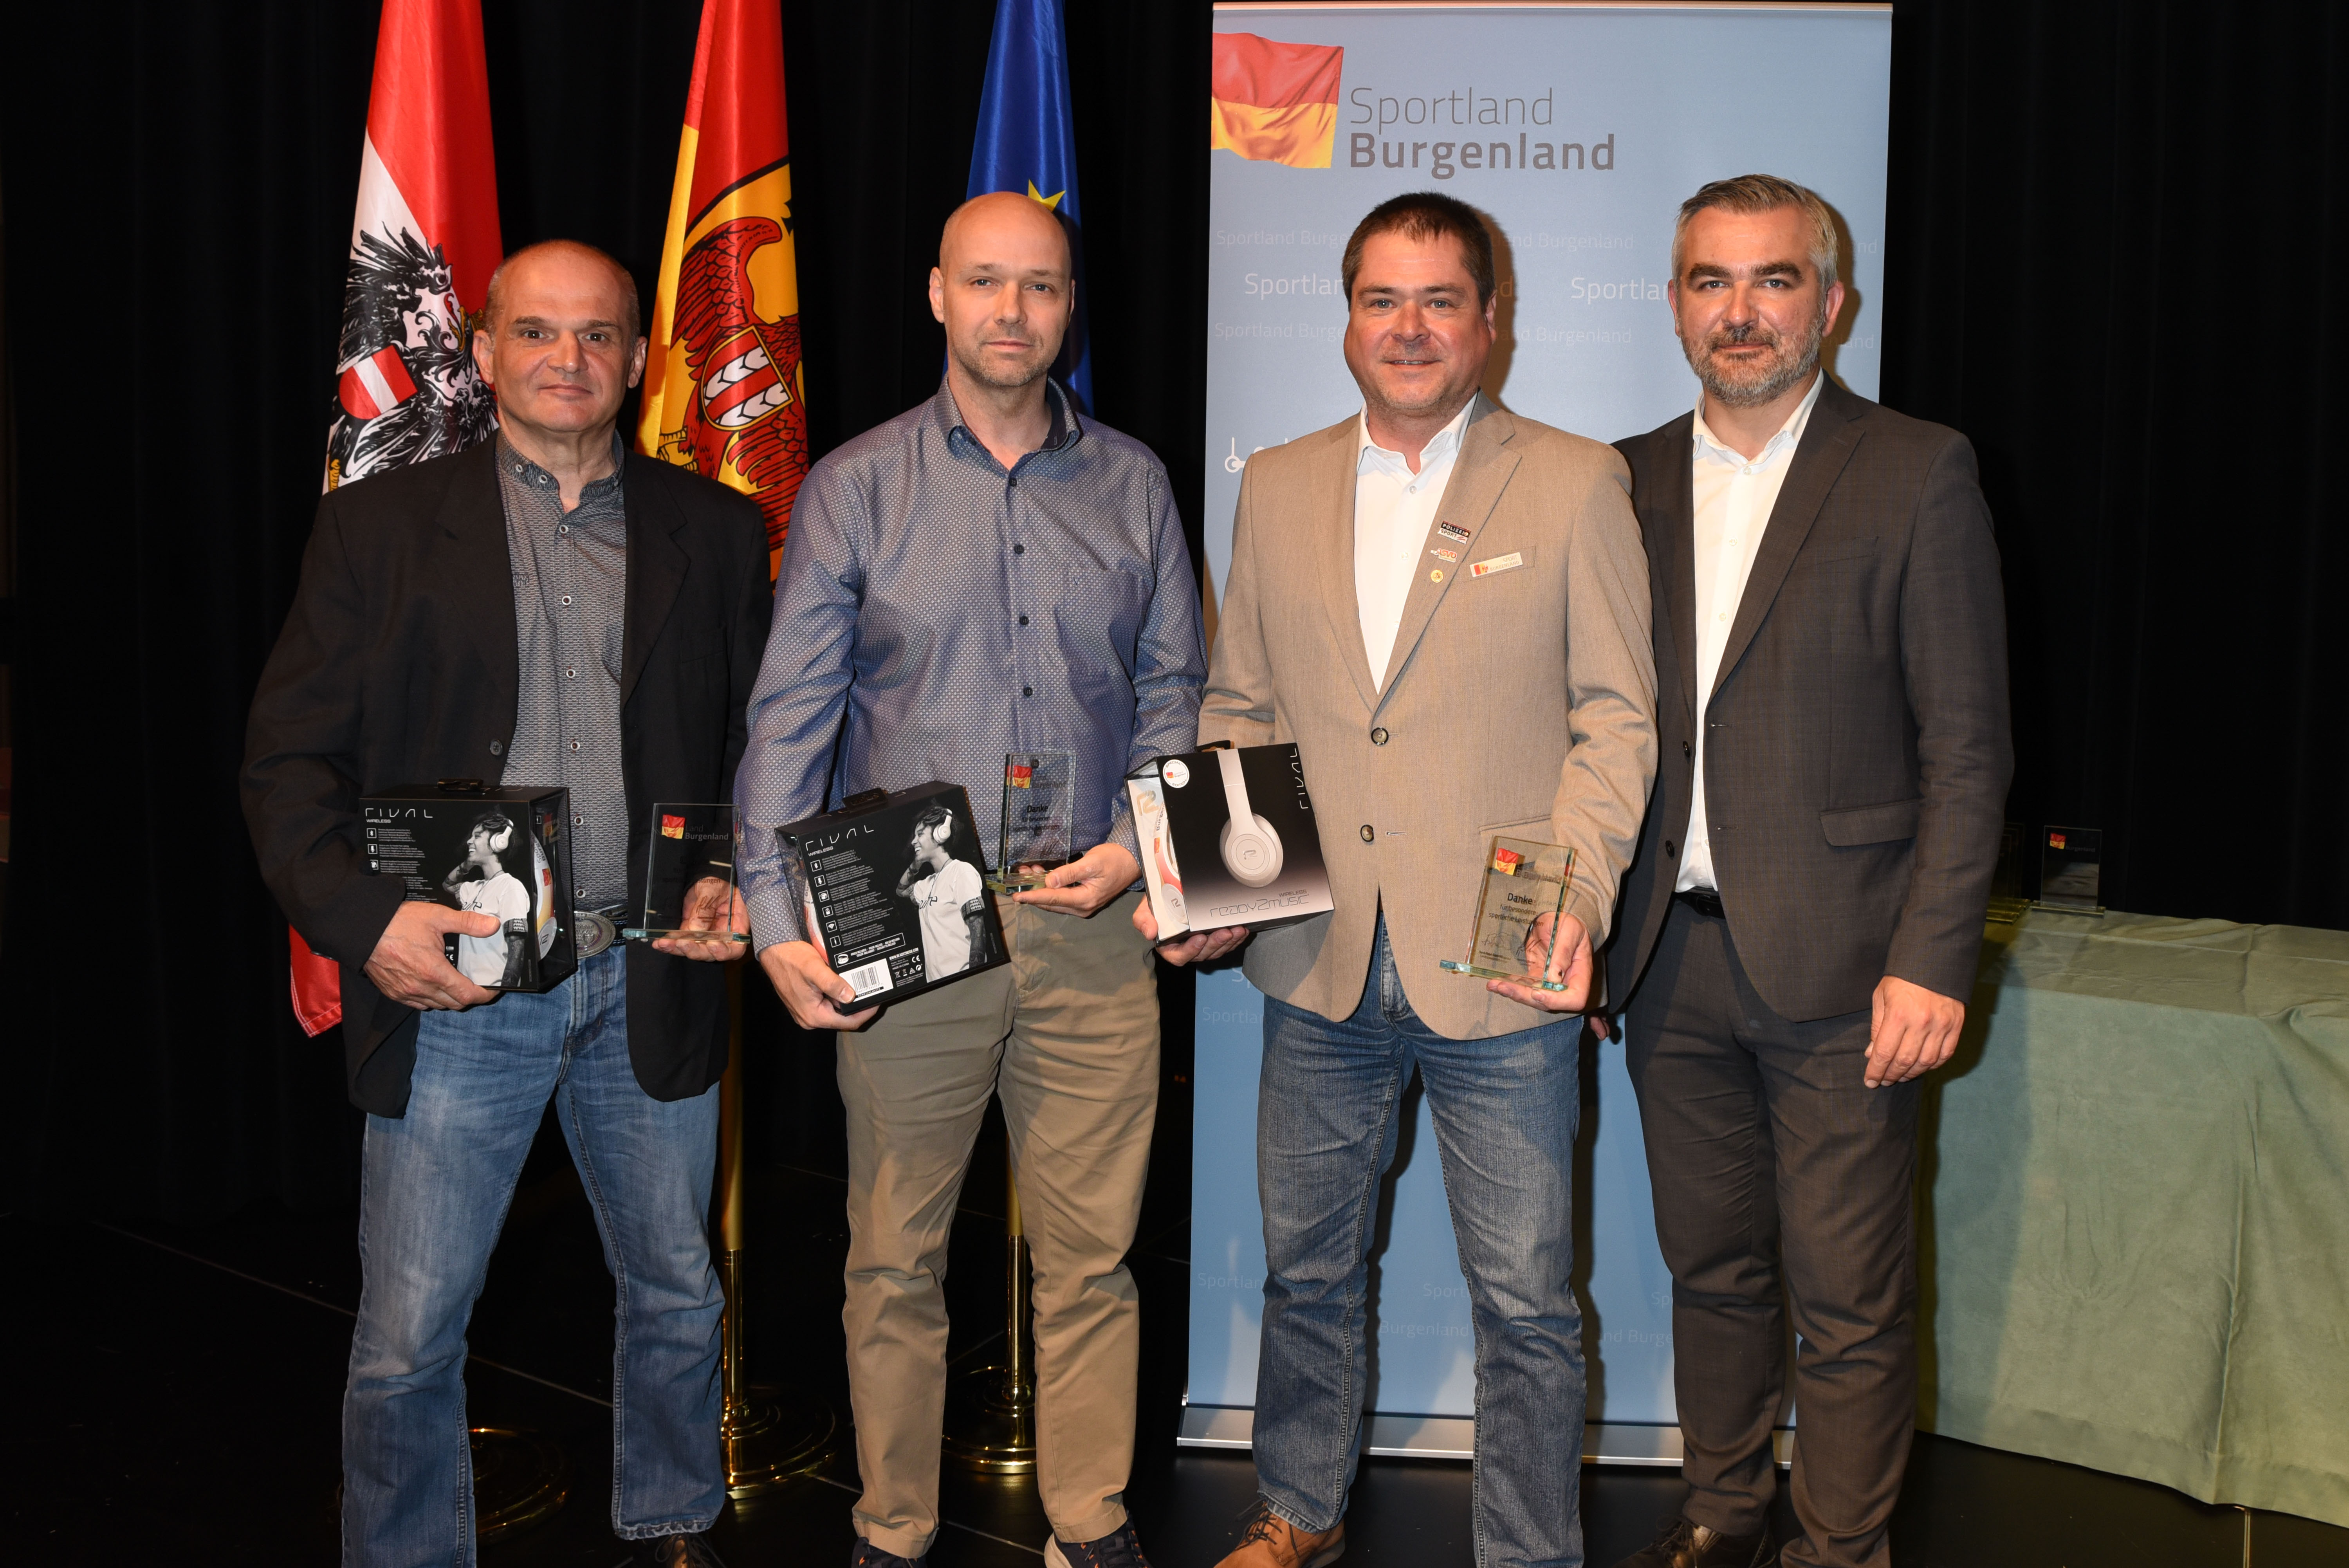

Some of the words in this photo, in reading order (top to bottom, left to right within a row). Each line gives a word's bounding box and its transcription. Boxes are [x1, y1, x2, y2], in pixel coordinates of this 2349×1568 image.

[1350, 87, 1552, 135] Sportland
[1350, 132, 1615, 180] Burgenland
[1216, 230, 1295, 248] Sportland
[1301, 230, 1350, 249] Burge
[1538, 233, 1634, 252] Burgenland
[1215, 323, 1292, 341] Sportland
[1299, 323, 1346, 342] Burge
[1537, 327, 1632, 346] Burgenland
[1440, 529, 1458, 538] SPORT
[1027, 805, 1049, 813] Danke
[686, 824, 704, 832] Land
[685, 832, 729, 841] Burgenland
[808, 846, 834, 857] WIRELESS
[1279, 889, 1307, 898] WIRELESS
[1507, 892, 1533, 905] Danke
[1508, 905, 1537, 915] besondere
[1488, 912, 1514, 922] sportliche
[1515, 917, 1544, 927] Leistungen
[1423, 1283, 1469, 1300] Sport
[1379, 1320, 1469, 1338] Burgenland
[1628, 1330, 1673, 1347] Burge
